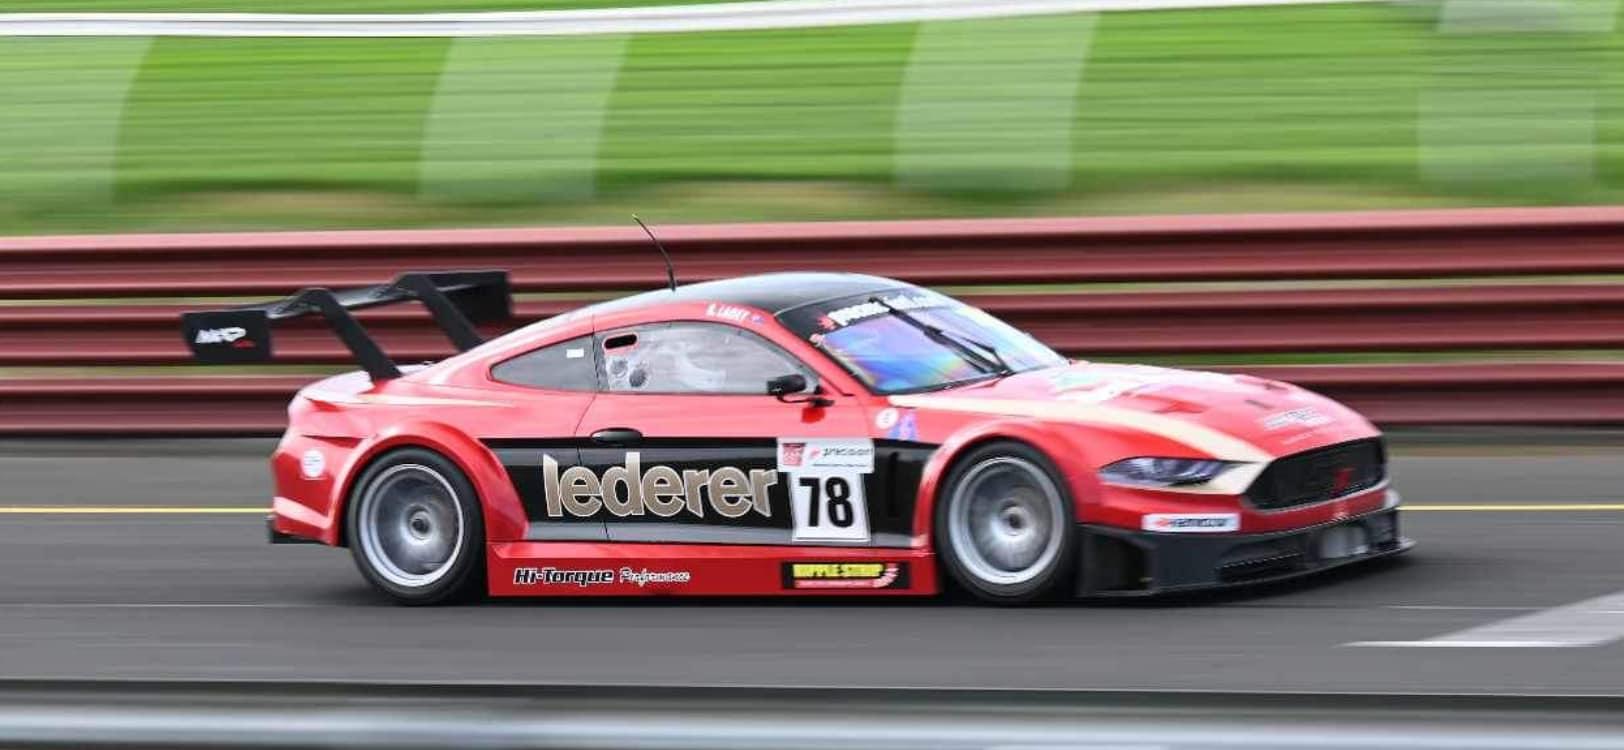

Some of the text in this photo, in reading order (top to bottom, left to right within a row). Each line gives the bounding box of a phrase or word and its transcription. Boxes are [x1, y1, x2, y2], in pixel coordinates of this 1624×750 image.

[542, 451, 779, 518] lederer
[798, 476, 856, 529] 78
[513, 567, 614, 587] Hi-Torque
